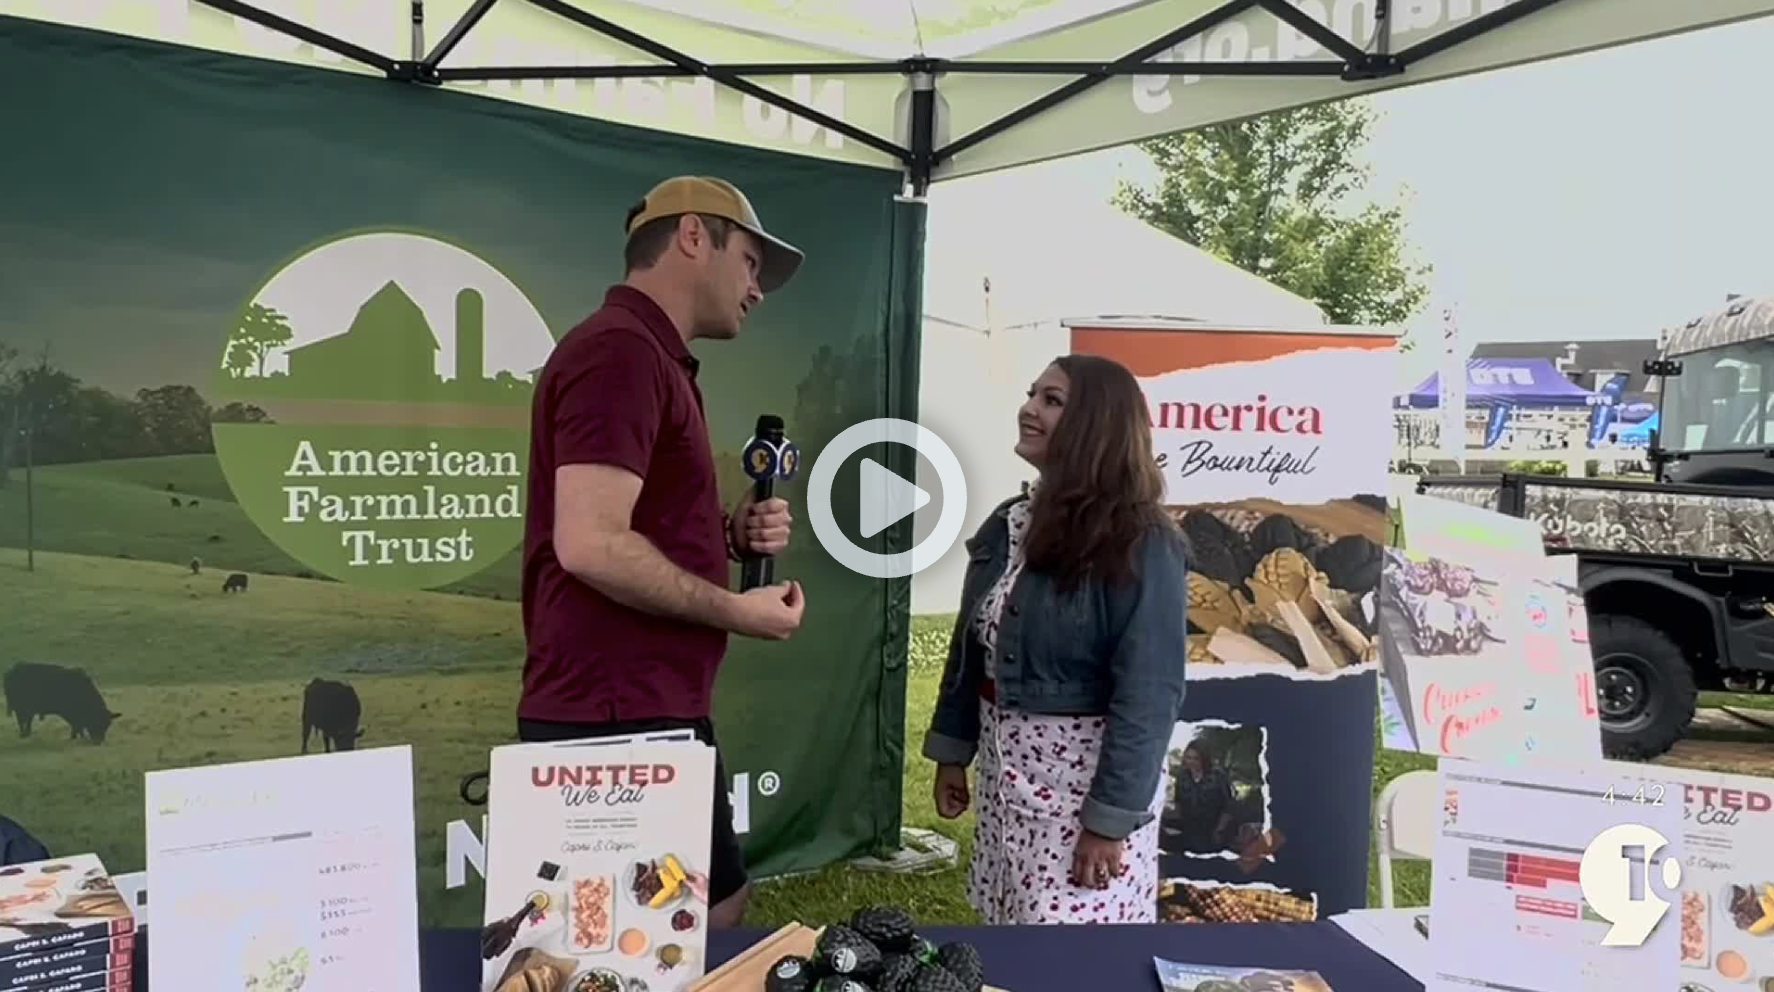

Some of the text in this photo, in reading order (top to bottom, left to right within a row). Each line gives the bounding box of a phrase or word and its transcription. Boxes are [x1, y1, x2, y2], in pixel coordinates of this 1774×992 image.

[1150, 394, 1323, 435] merica
[284, 441, 521, 476] American
[1180, 440, 1320, 486] Bountiful
[283, 485, 523, 522] Farmland
[342, 528, 474, 566] Trust
[532, 764, 676, 787] UNITED
[561, 783, 645, 807] We Eat
[1684, 783, 1772, 813] ITED
[1696, 804, 1740, 826] Eat
